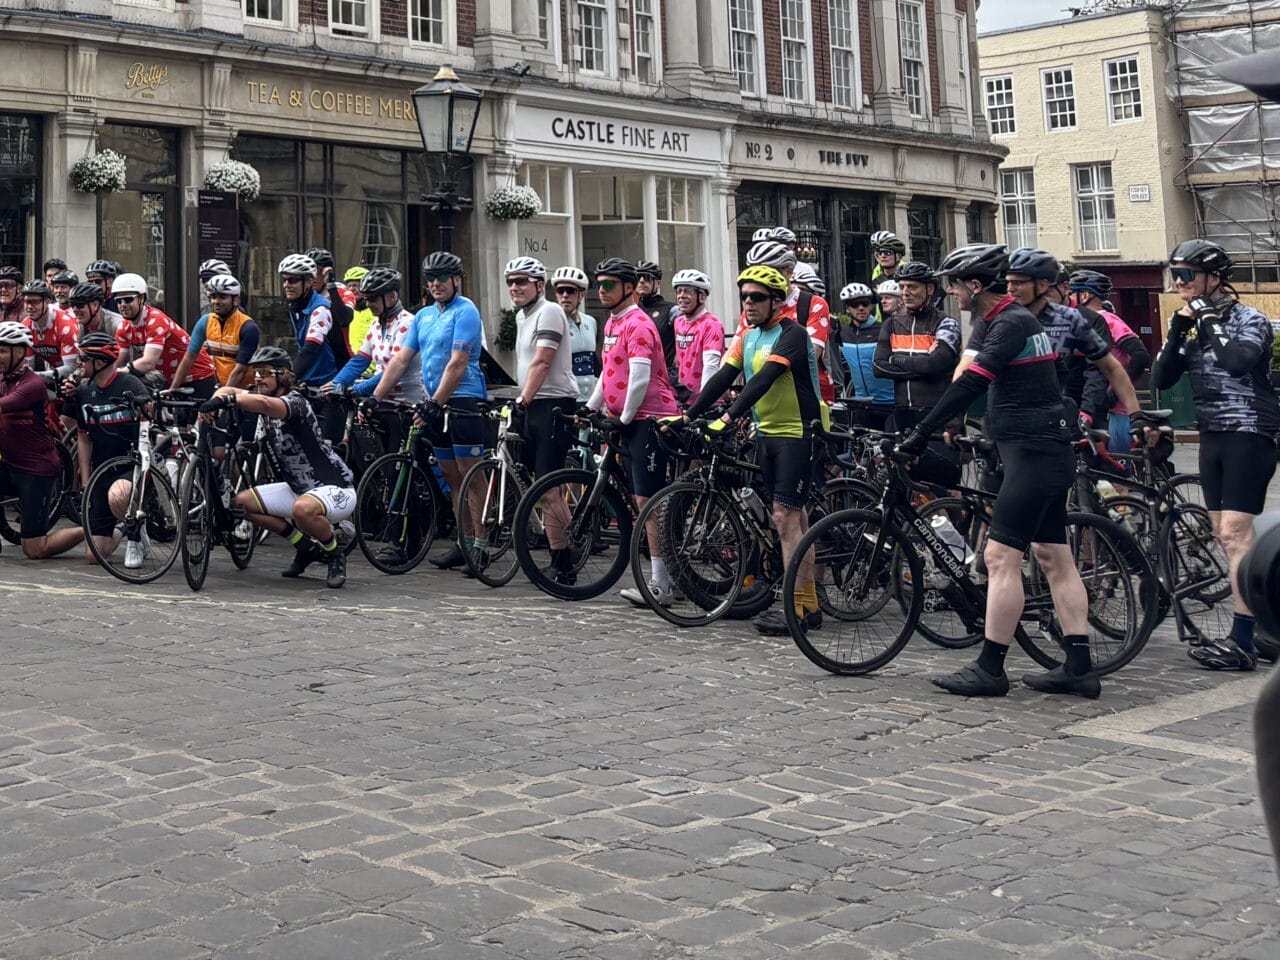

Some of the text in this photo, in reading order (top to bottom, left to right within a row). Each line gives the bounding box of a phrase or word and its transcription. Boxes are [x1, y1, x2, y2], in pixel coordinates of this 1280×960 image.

[125, 62, 169, 95] Bettys
[247, 79, 282, 106] TEA
[289, 90, 303, 108] &
[309, 88, 373, 117] COFFEE
[551, 117, 690, 152] CASTLE FINE ART
[765, 143, 774, 161] 2
[524, 237, 548, 254] No 4
[913, 518, 964, 579] cannondale
